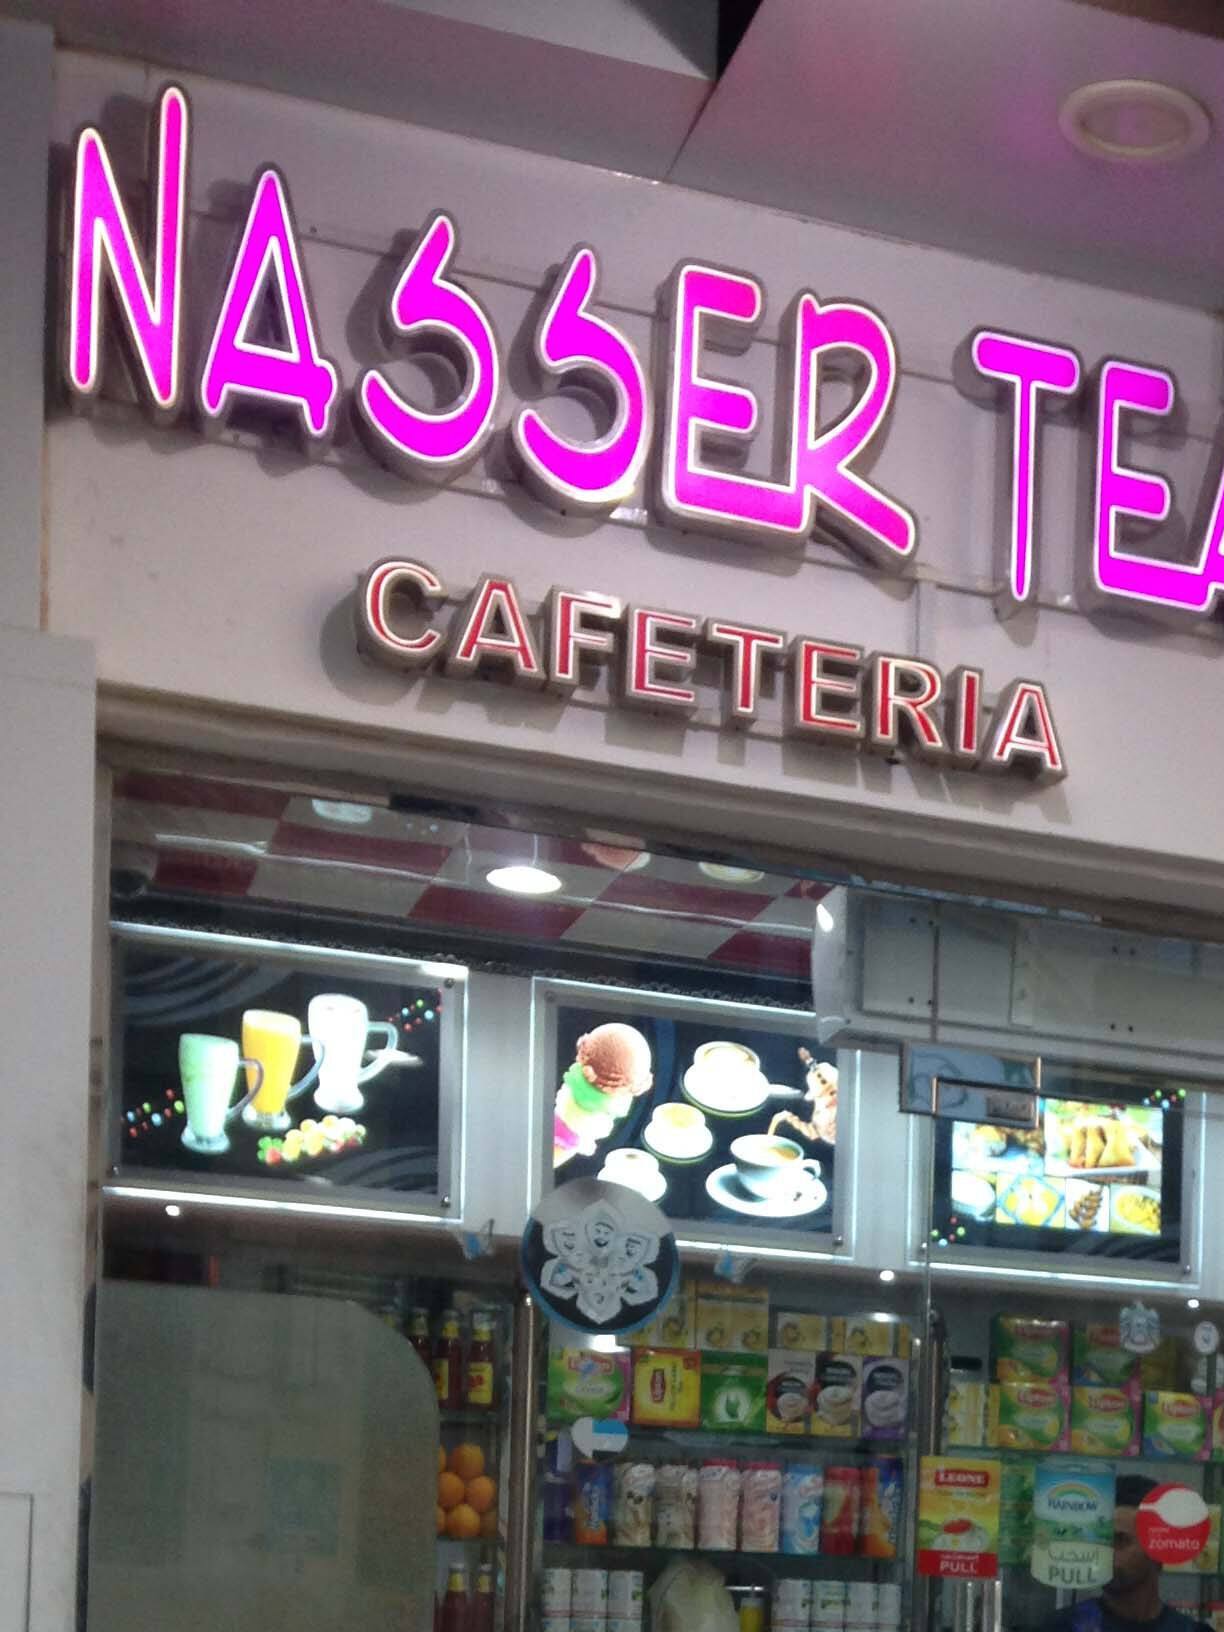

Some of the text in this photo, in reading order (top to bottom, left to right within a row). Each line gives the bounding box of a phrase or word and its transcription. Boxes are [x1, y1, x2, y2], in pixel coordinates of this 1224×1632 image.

[69, 86, 916, 562] NASSER
[364, 557, 1066, 776] CAFETERIA
[1149, 1538, 1200, 1550] zomato
[939, 1560, 978, 1574] PULL
[1048, 1566, 1098, 1585] PULL
